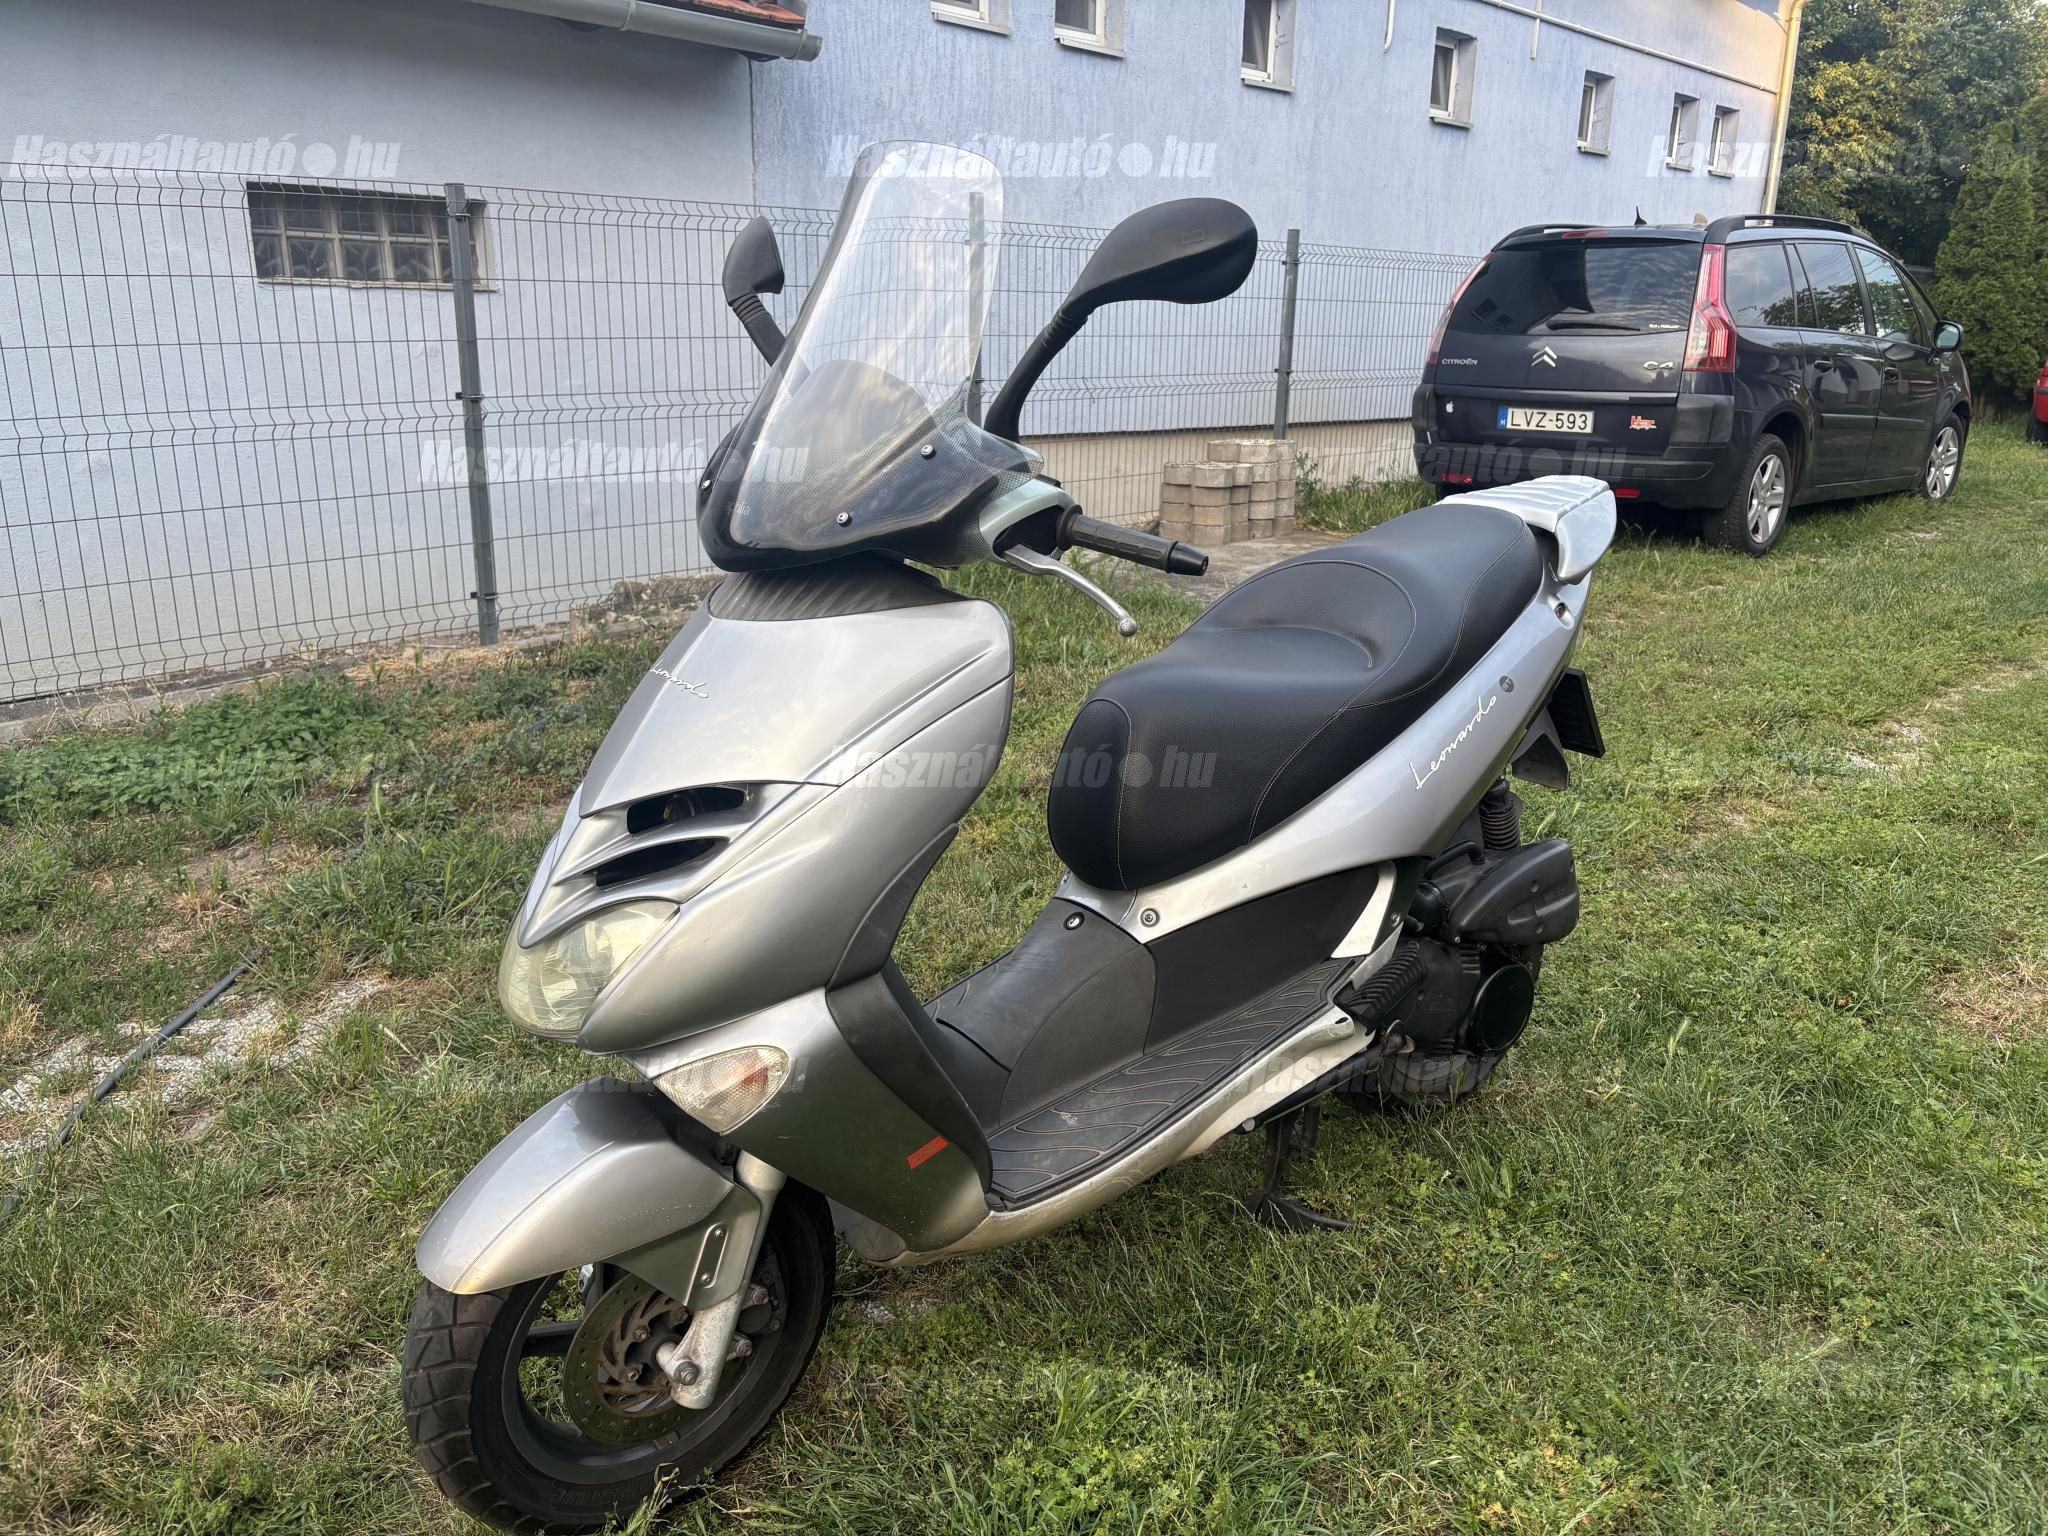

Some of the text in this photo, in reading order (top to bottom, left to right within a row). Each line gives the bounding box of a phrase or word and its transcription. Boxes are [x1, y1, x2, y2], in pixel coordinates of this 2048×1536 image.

[1643, 360, 1674, 370] C4
[1510, 409, 1588, 431] LVZ-593
[1409, 695, 1497, 791] Leonardo
